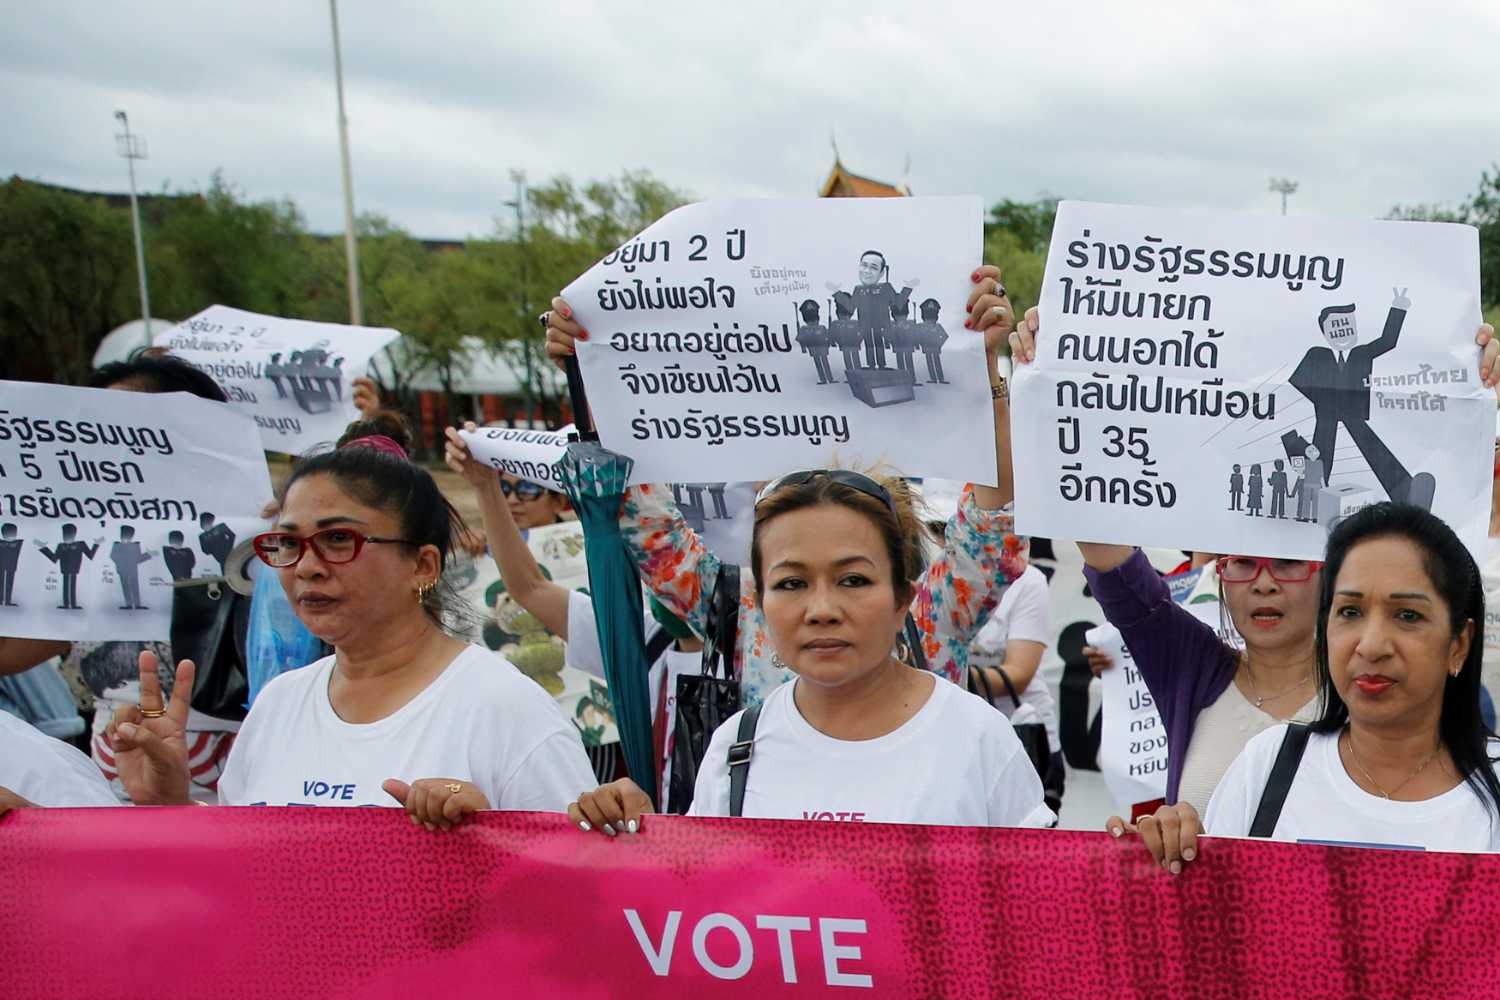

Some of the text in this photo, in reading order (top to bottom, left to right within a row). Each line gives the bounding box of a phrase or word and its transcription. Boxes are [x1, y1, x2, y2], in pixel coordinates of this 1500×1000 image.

[688, 234, 708, 261] 2
[726, 228, 746, 260] ปี
[1065, 229, 1345, 292] ร่างรัฐธรรมนูญ
[597, 277, 736, 311] ยังไม่พอใจ
[1059, 275, 1212, 322] ให้มีนายก
[609, 322, 793, 361] อยากอยู่ต่อไป
[1057, 328, 1225, 369] คนนอกได้
[1329, 327, 1355, 339] นอก
[618, 362, 782, 395] จึงเขียนไว้ใน
[1055, 371, 1276, 421] กลับไปเหมือน
[631, 408, 850, 446] ร่างรัฐธรรมนูญ
[1057, 416, 1150, 460] ปี 35
[20, 453, 43, 480] 5
[56, 450, 145, 484] ปีแรก
[1059, 457, 1178, 509] อีกครั้ง
[0, 486, 198, 528] ารยึดวุฒิสภา
[303, 780, 356, 800] VOTE
[623, 908, 874, 989] VOTE
